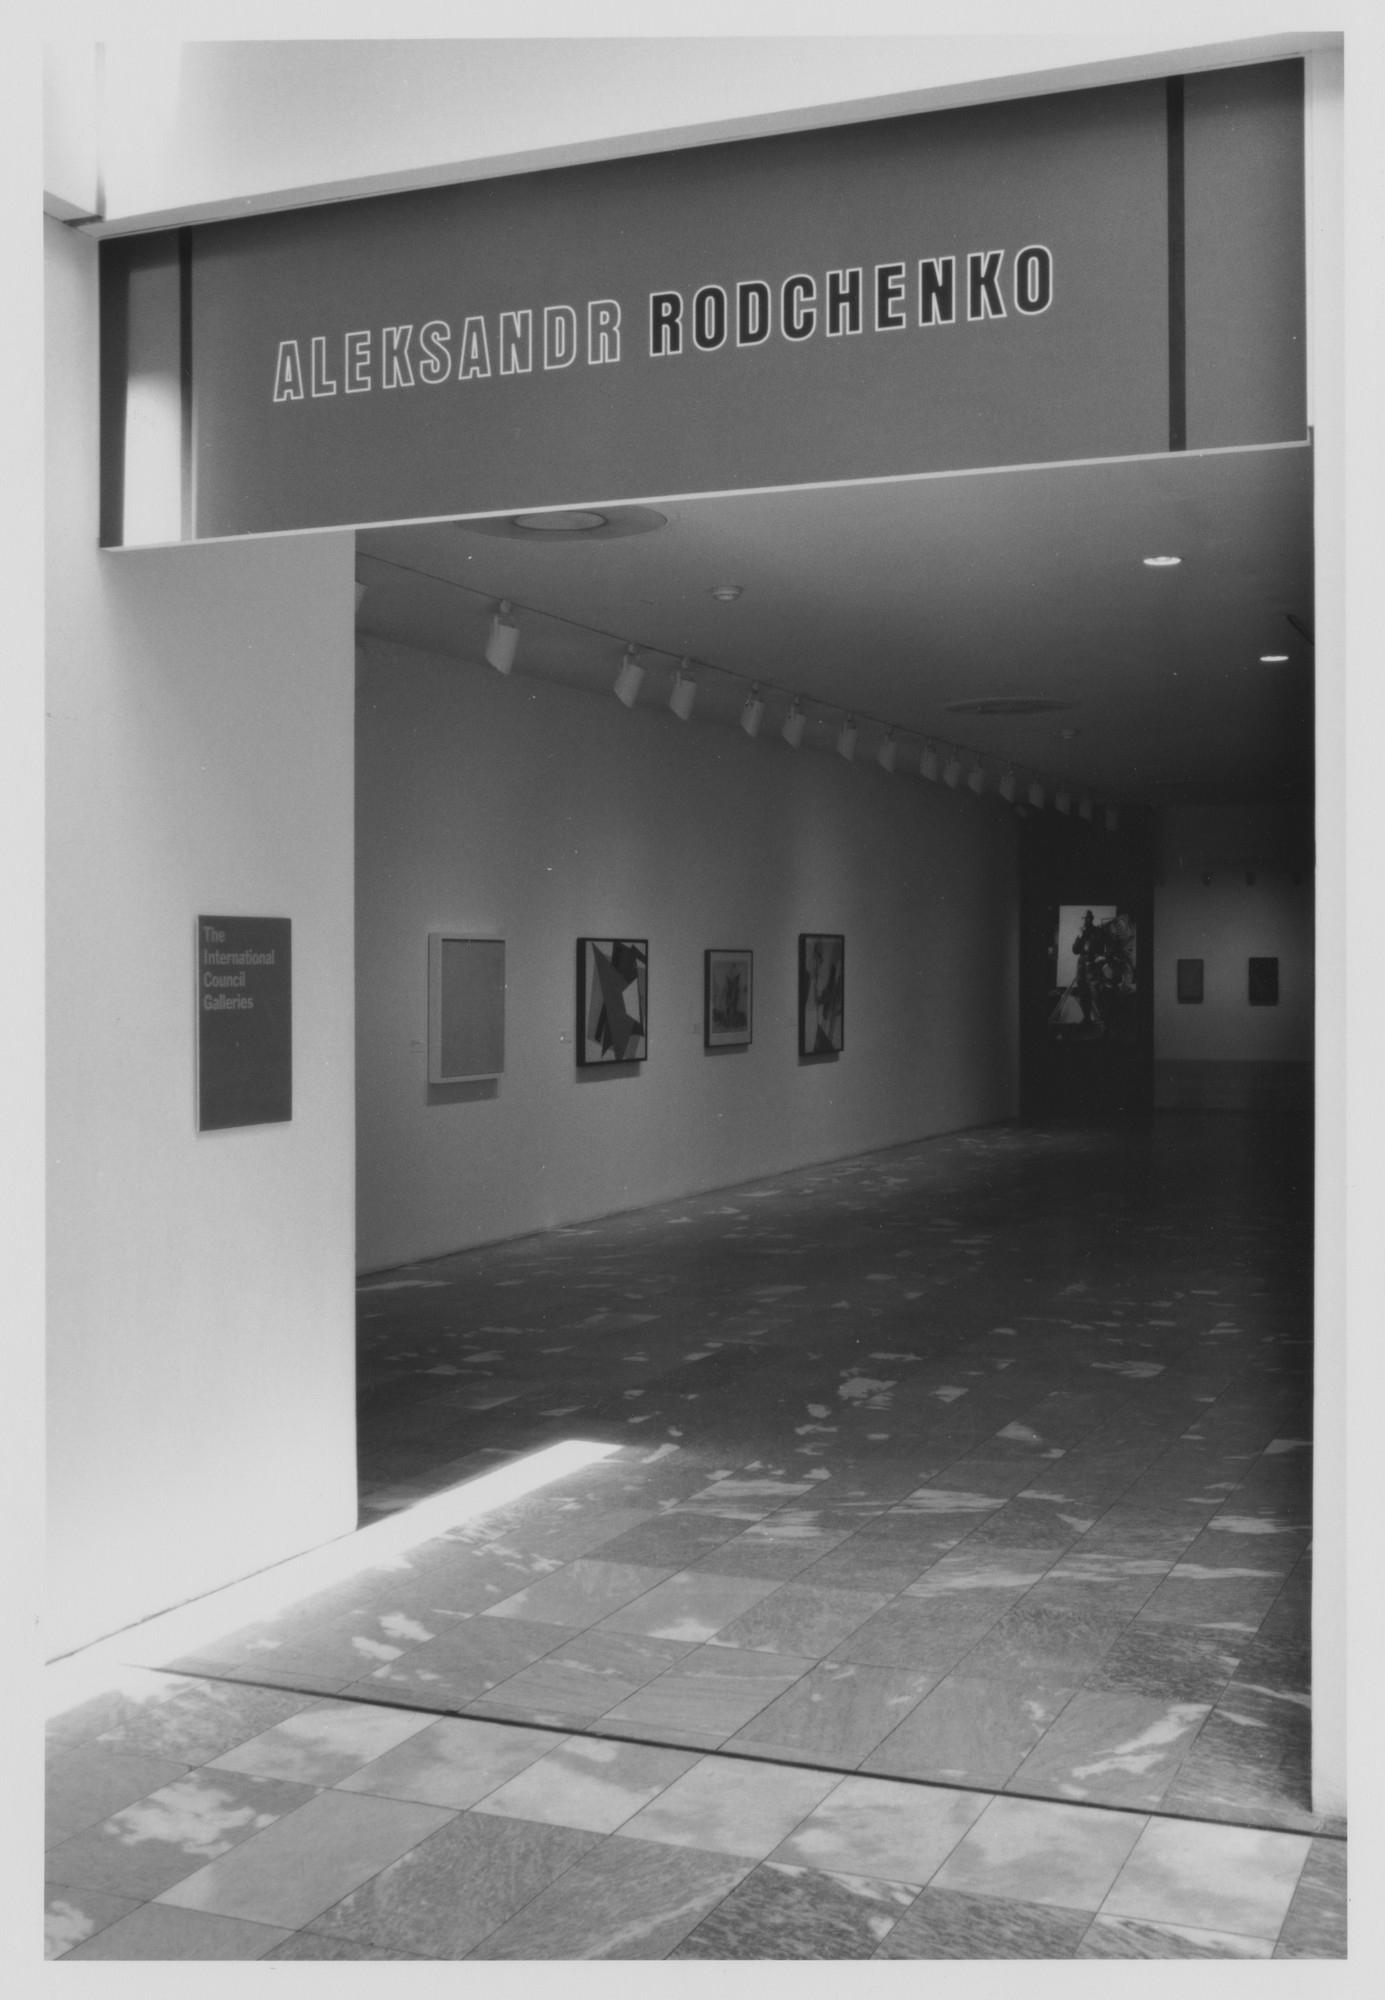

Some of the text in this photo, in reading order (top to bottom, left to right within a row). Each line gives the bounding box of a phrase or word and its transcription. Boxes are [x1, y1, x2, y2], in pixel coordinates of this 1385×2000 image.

[273, 245, 1053, 402] ALEKSANDR RODCHENKO
[203, 926, 226, 942] The
[203, 949, 275, 965] International
[203, 971, 246, 988] Council
[203, 994, 254, 1010] Galleries
